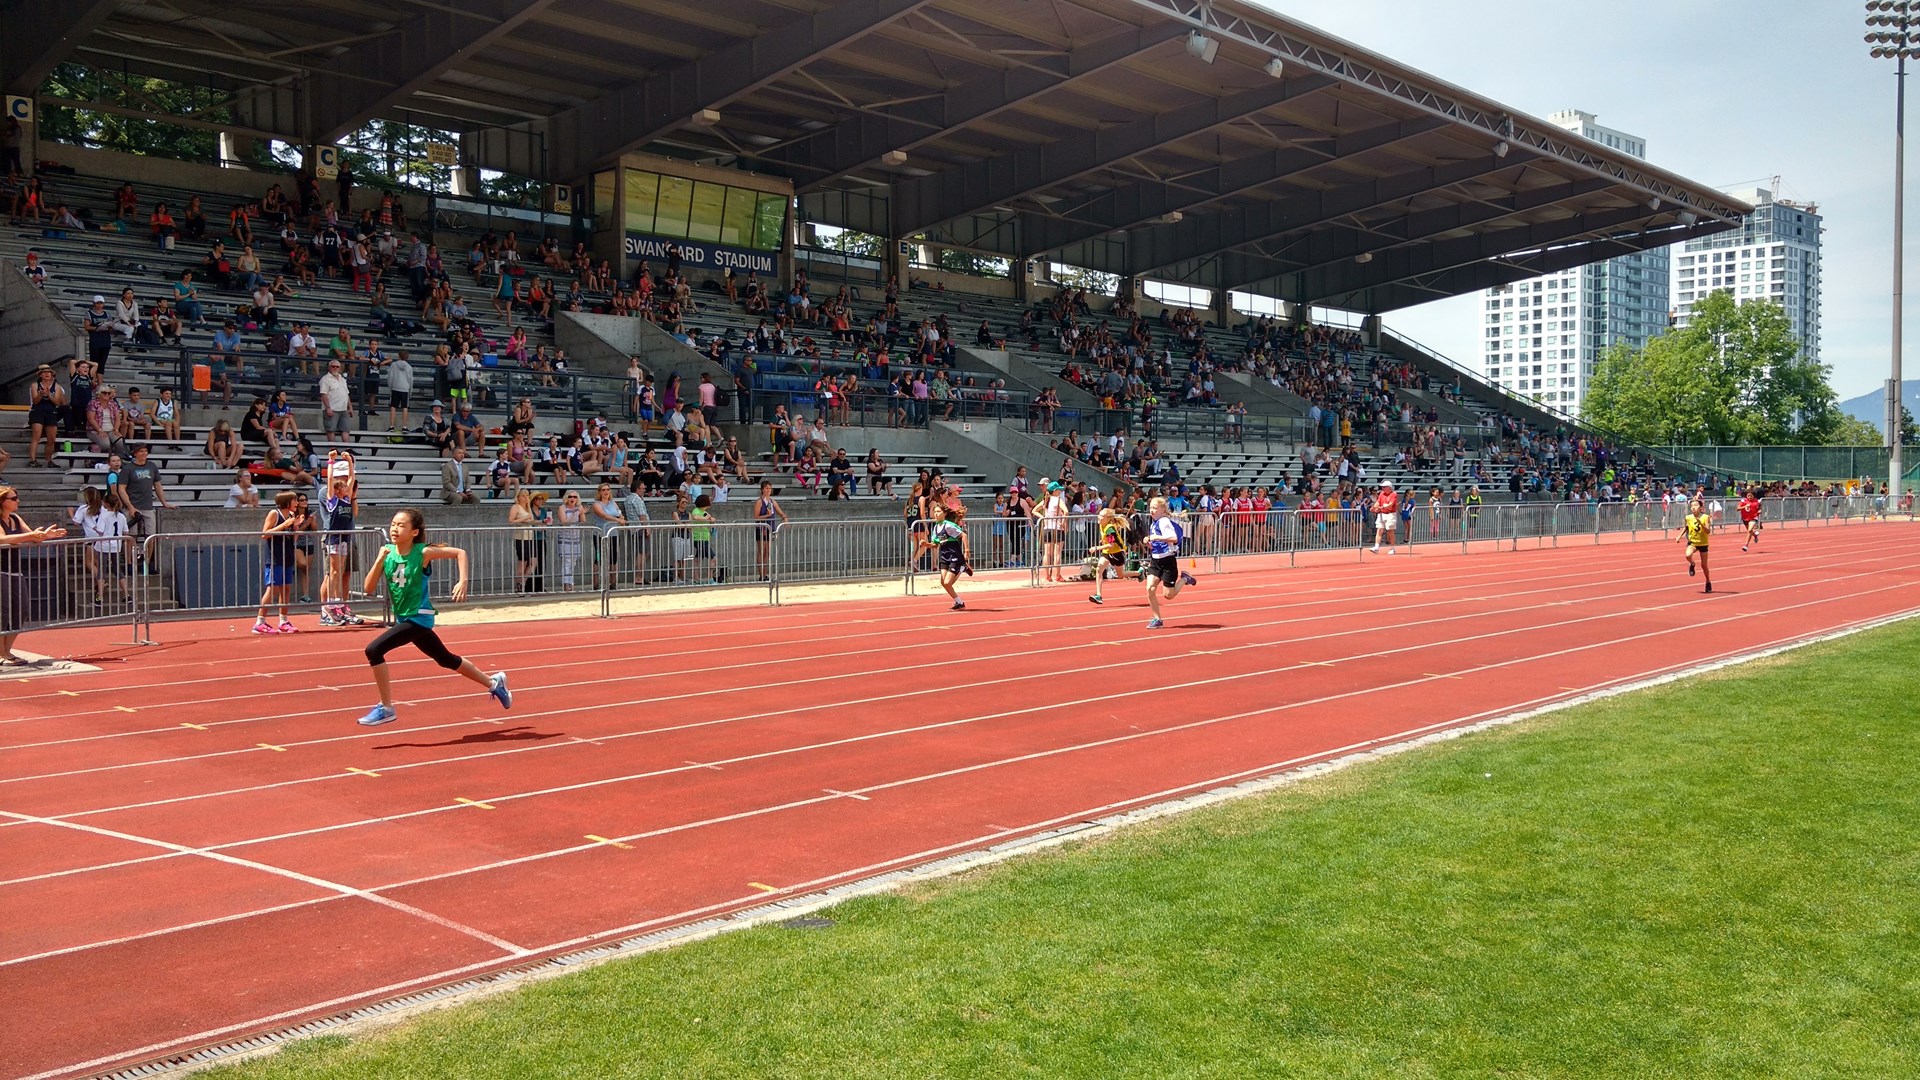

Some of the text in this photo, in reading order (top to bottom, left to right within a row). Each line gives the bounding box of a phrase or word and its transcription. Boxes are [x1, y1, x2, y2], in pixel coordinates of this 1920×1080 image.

[12, 99, 28, 118] C
[321, 149, 334, 166] C
[559, 187, 568, 201] D
[325, 237, 335, 245] 77
[900, 242, 908, 254] E
[714, 250, 771, 272] STADIUM
[1027, 263, 1033, 273] E
[1135, 279, 1140, 289] F
[906, 504, 919, 517] 36
[113, 521, 119, 536] 1
[1694, 521, 1701, 532] 3
[392, 563, 407, 588] 4
